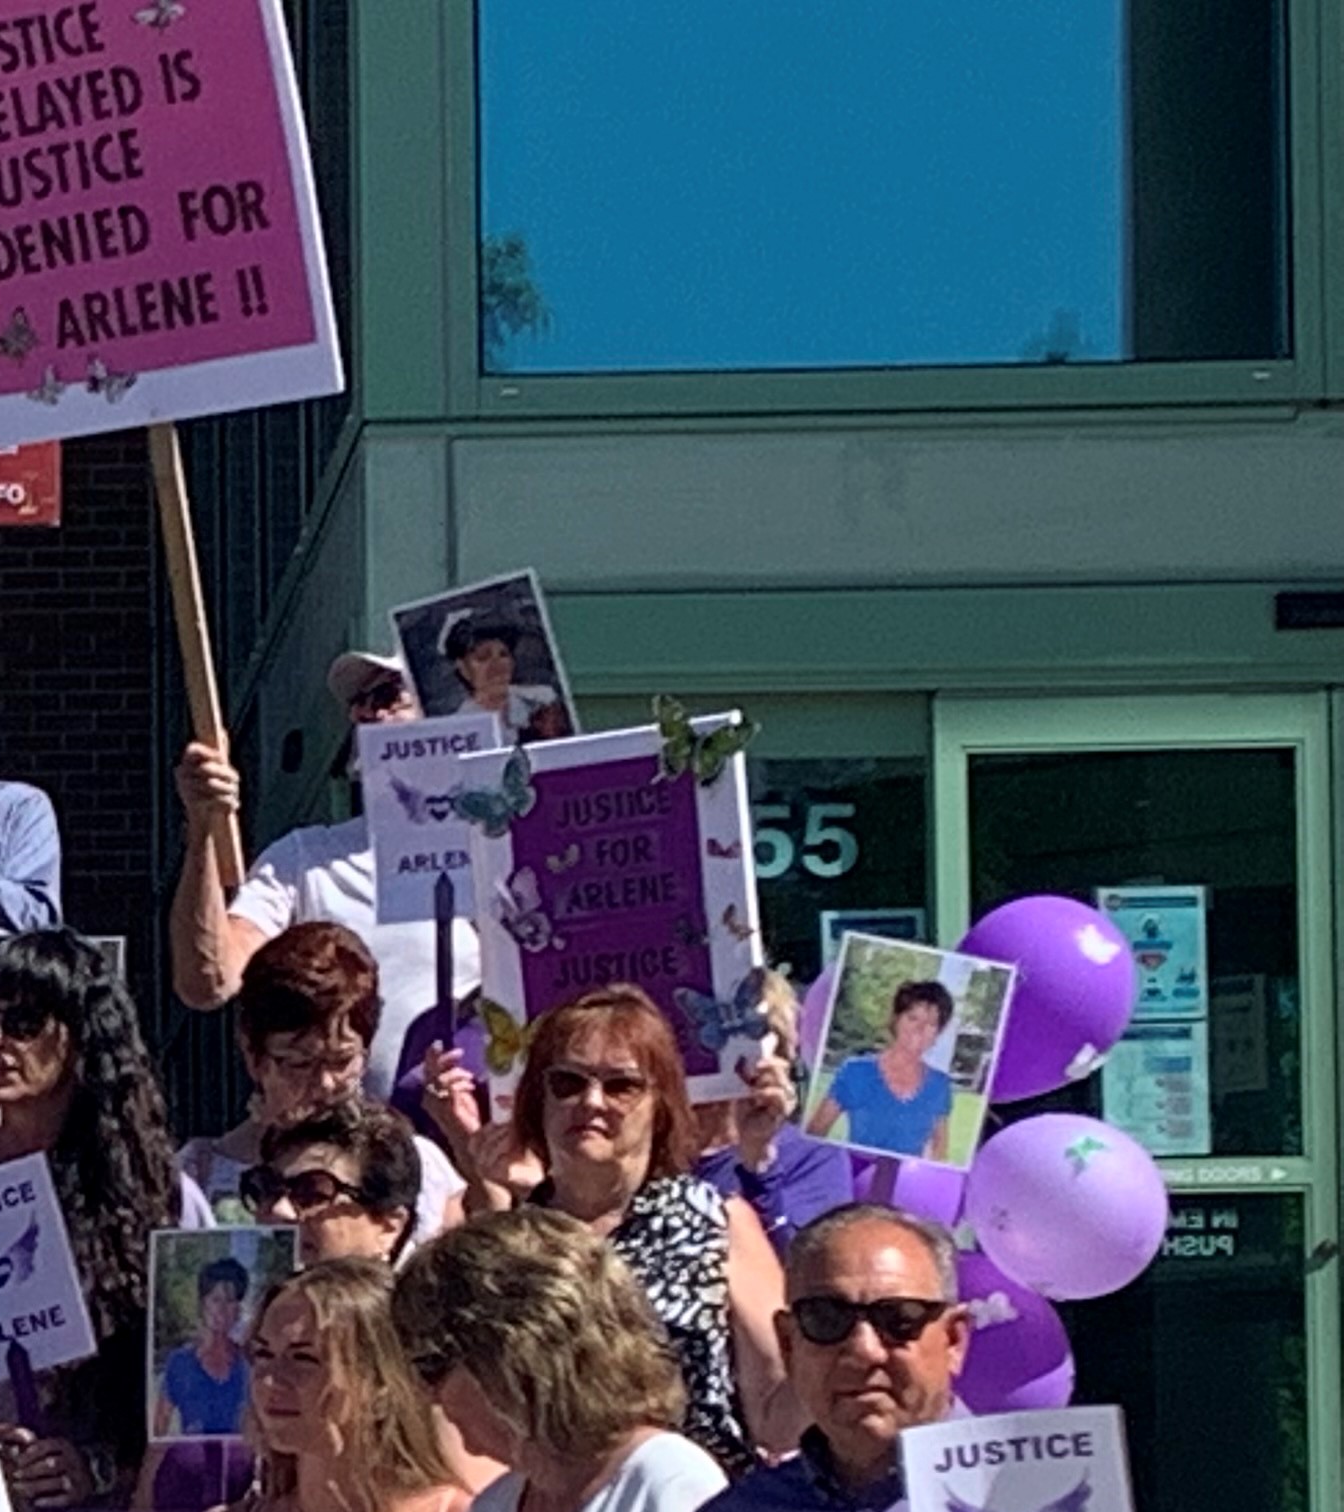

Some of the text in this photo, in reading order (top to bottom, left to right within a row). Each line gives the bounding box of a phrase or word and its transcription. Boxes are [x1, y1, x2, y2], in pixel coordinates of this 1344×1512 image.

[159, 50, 201, 104] IS
[178, 180, 270, 241] FOR
[57, 265, 269, 349] ARLENE !!
[380, 732, 482, 761] JUSTICE
[398, 851, 471, 874] ARLEN
[595, 835, 657, 867] FOR
[565, 872, 675, 914] ARLENE
[553, 946, 678, 989] JUSTICE
[934, 1432, 1094, 1473] JUSTICE
